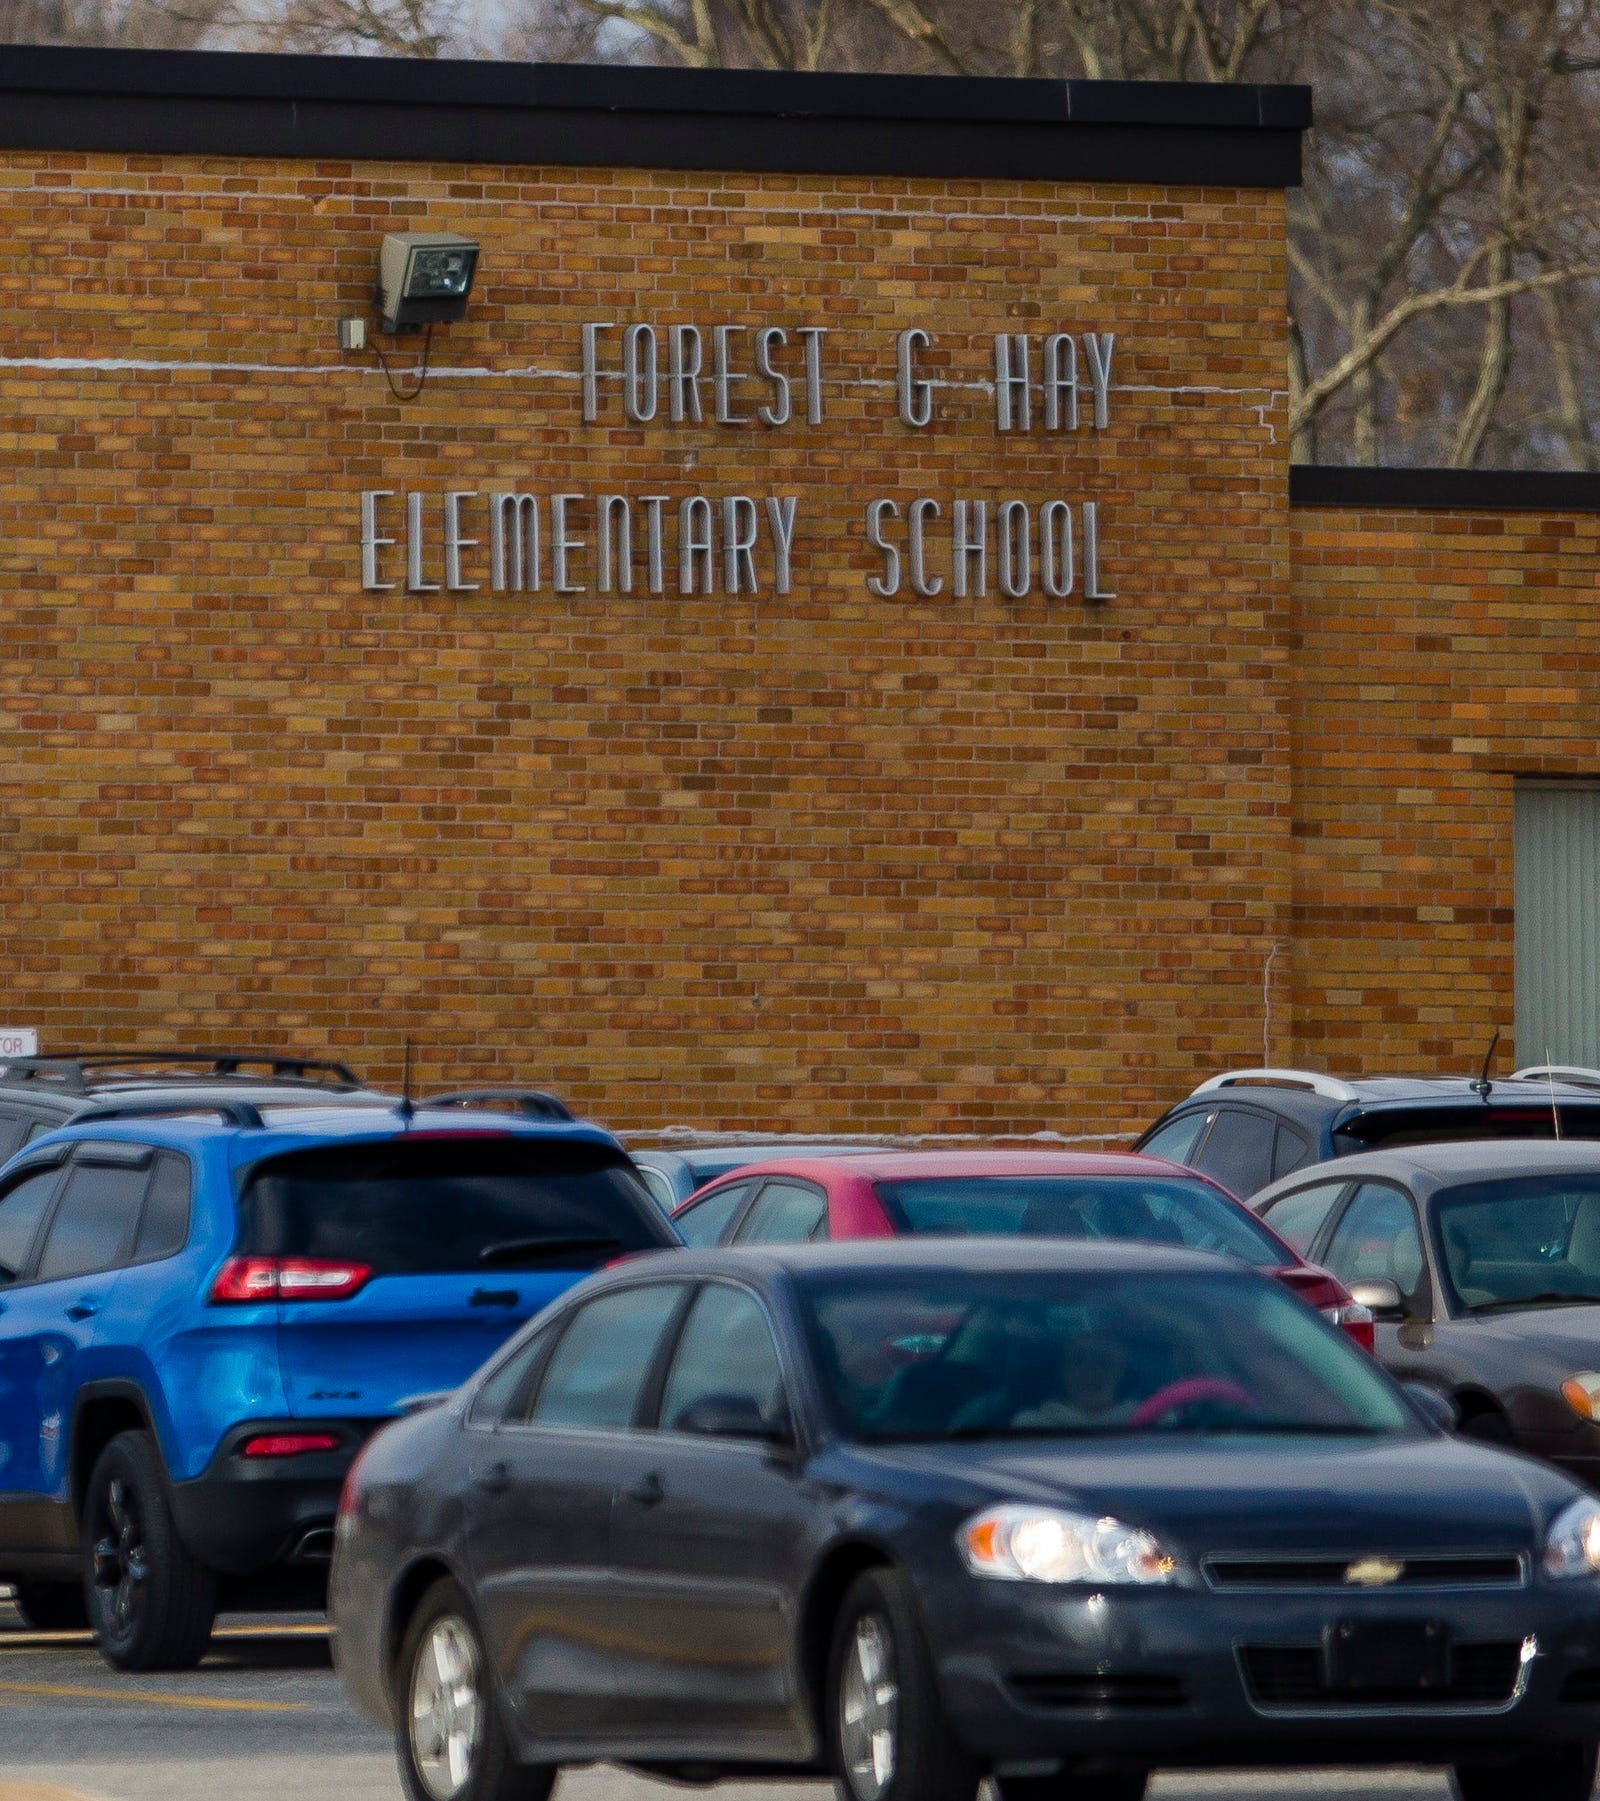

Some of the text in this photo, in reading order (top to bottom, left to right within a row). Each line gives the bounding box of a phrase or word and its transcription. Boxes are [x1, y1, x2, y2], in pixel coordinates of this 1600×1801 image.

[582, 322, 1116, 431] FOREST G HAY
[360, 490, 1117, 600] ELEMENTARY SCHOOL
